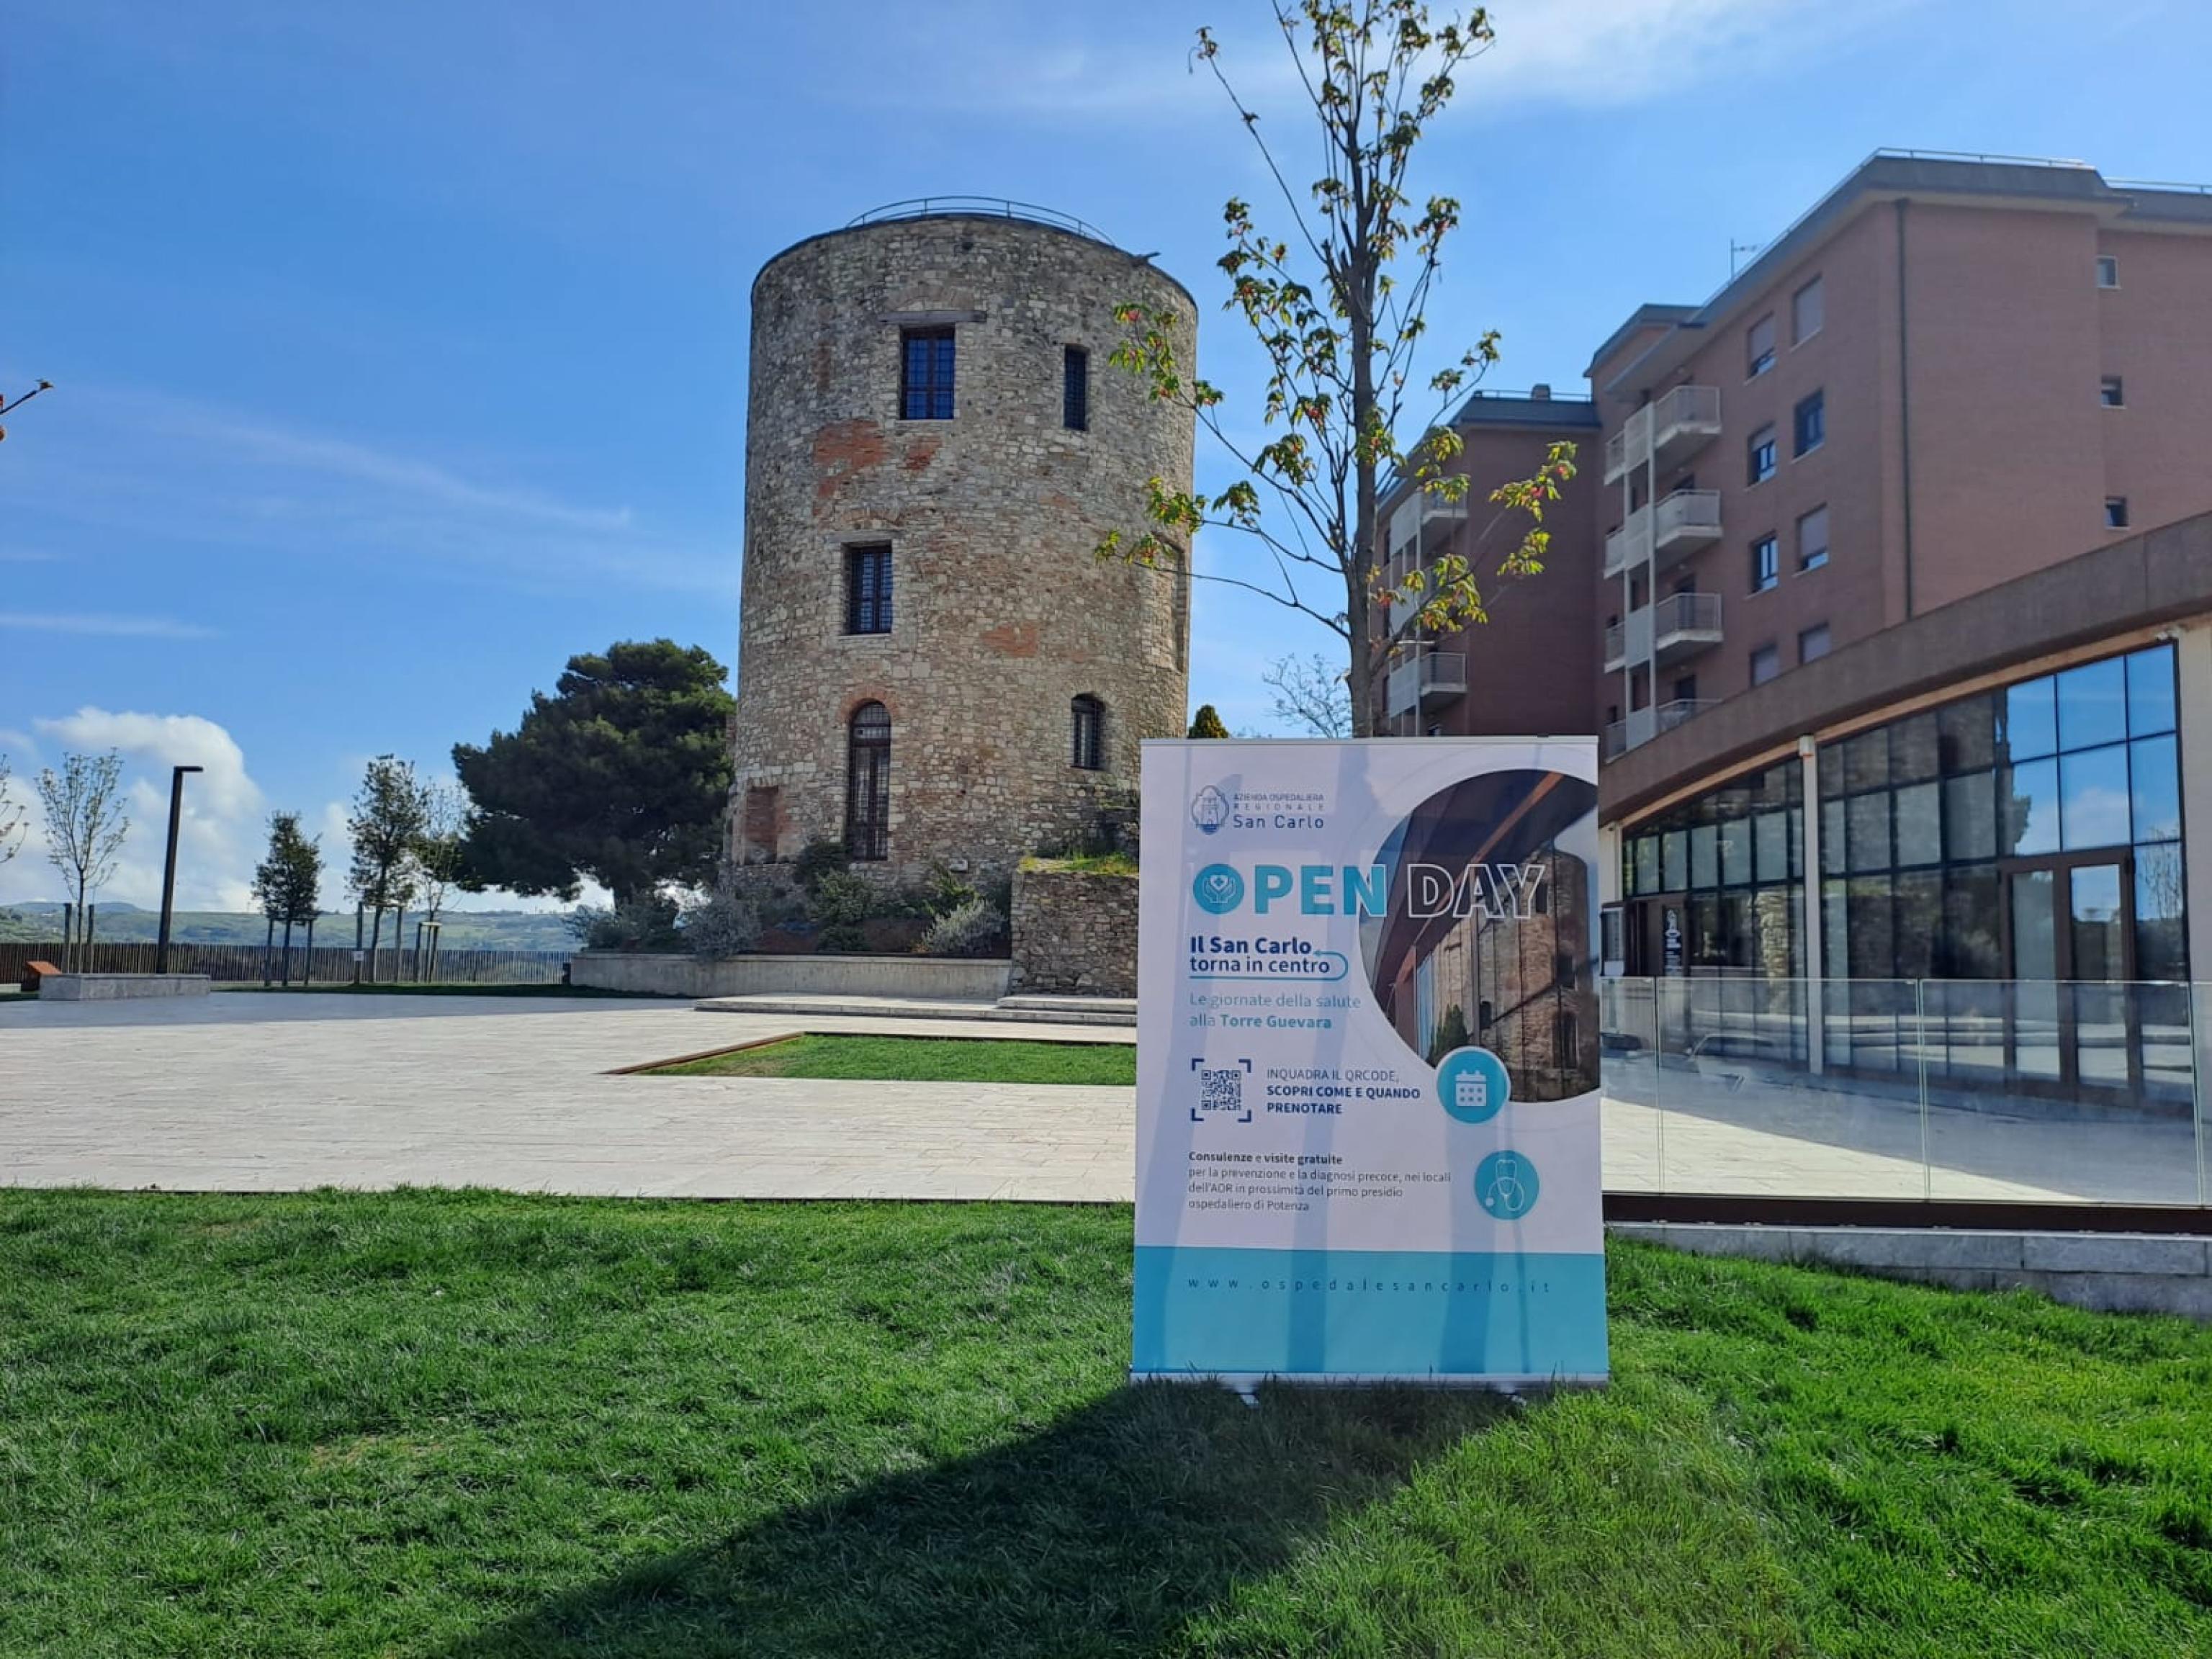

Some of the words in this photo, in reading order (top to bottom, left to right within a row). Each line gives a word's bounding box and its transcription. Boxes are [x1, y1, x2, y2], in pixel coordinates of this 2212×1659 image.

[1233, 814, 1266, 828] San
[1274, 814, 1324, 829] Carlo
[1407, 863, 1546, 920] DAY
[1190, 935, 1205, 953] Il
[1210, 936, 1249, 954] San
[1254, 937, 1312, 955] Carlo
[1190, 956, 1241, 971] torna
[1246, 956, 1263, 973] in
[1268, 958, 1331, 974] centro
[1190, 993, 1207, 1006] Le
[1210, 994, 1272, 1010] giornate
[1275, 994, 1312, 1008] della
[1316, 994, 1362, 1009] salute
[1190, 1014, 1215, 1028] alla
[1220, 1015, 1263, 1028] Torre
[1266, 1015, 1332, 1030] Guevara
[1267, 1069, 1329, 1082] INQUADRA
[1332, 1069, 1342, 1081] IL
[1345, 1070, 1400, 1084] QRCODE,
[1267, 1085, 1313, 1097] SCOPRI
[1316, 1086, 1352, 1098] COME
[1355, 1087, 1362, 1097] E
[1366, 1087, 1421, 1100] QUANDO
[1267, 1102, 1343, 1115] PRENOTARE
[1188, 1151, 1253, 1162] Consulenze
[1264, 1154, 1295, 1164] visite
[1298, 1154, 1343, 1166] gratuite
[1188, 1168, 1205, 1179] per
[1209, 1167, 1218, 1177] la
[1221, 1169, 1286, 1181] prevenzione
[1298, 1169, 1307, 1179] la
[1310, 1169, 1355, 1182] diagnosi
[1358, 1172, 1403, 1183] precoce,
[1404, 1172, 1421, 1182] nei
[1423, 1172, 1451, 1182] locali
[1235, 1183, 1245, 1193] in
[1307, 1184, 1324, 1195] del
[1326, 1187, 1359, 1197] primo
[1361, 1187, 1403, 1198] presidio
[1188, 1198, 1251, 1210] ospedaliero
[1254, 1199, 1264, 1210] di
[1267, 1200, 1309, 1210] Potenza
